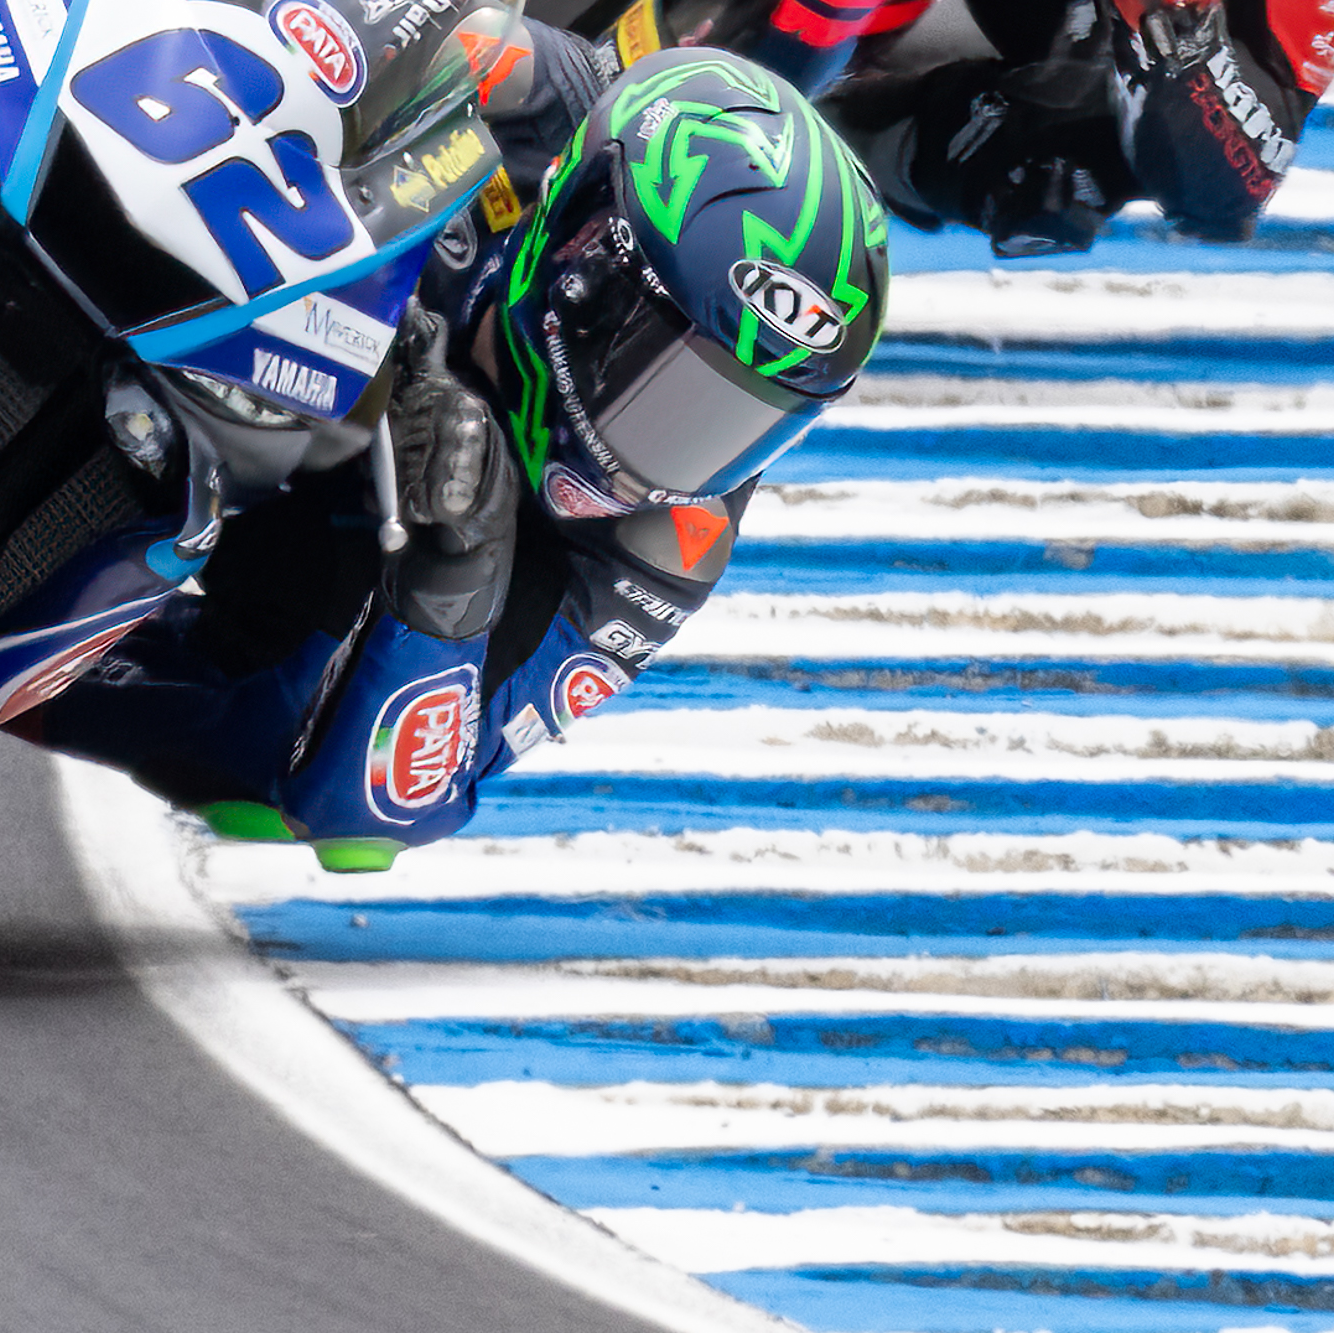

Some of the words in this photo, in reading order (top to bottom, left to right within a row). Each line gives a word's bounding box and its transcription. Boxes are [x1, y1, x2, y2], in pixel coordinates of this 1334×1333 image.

[288, 12, 350, 80] PATA
[70, 27, 355, 298] 62
[747, 272, 843, 345] KYT
[252, 348, 339, 412] YAMAHA
[406, 702, 458, 796] PATA
